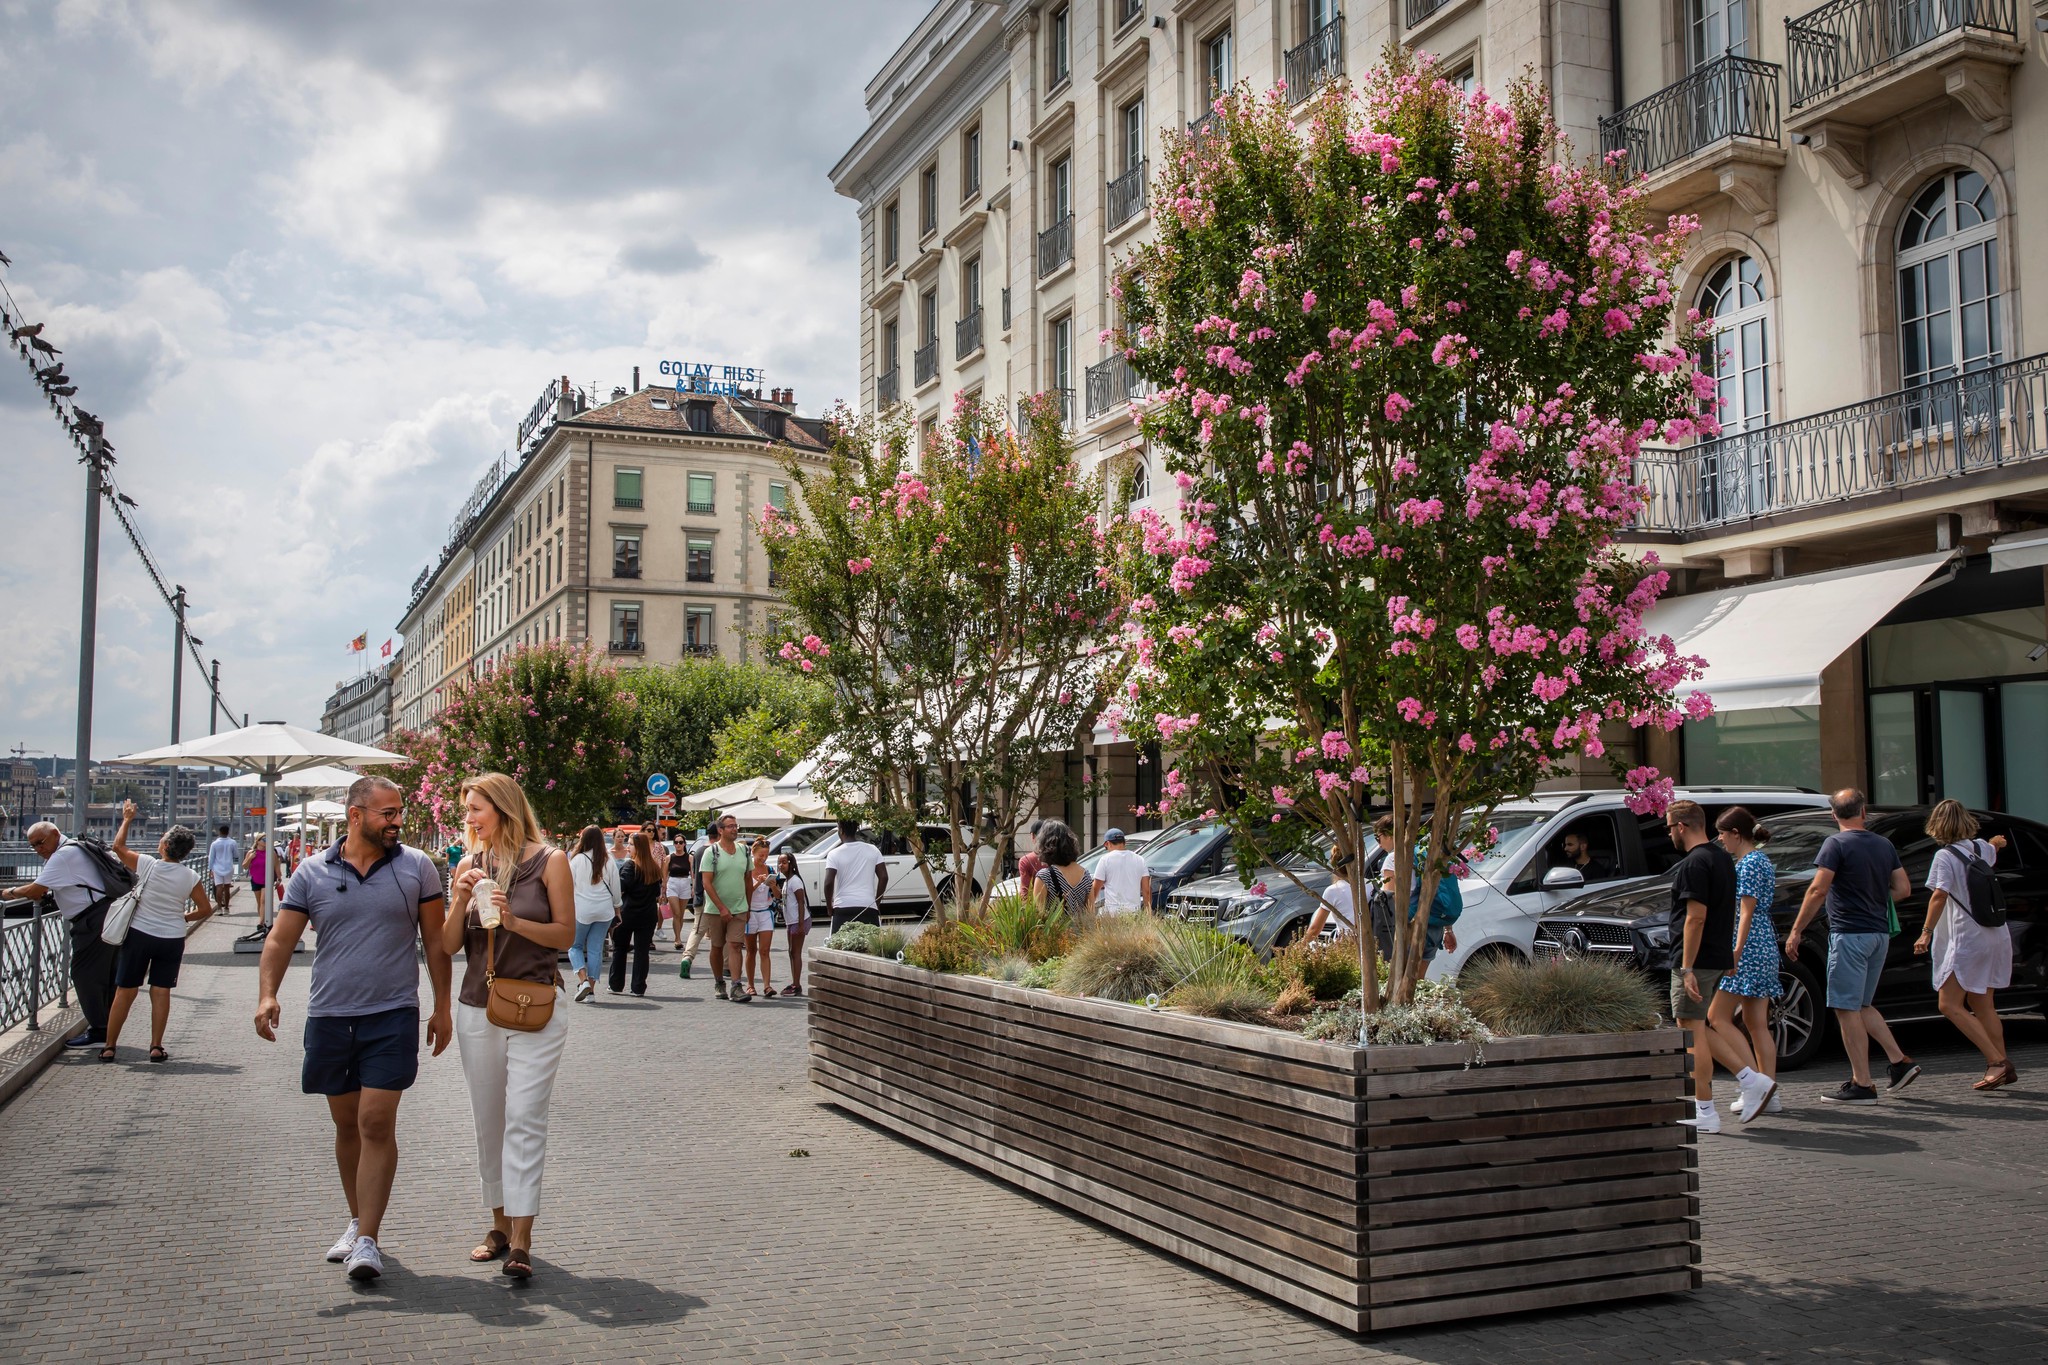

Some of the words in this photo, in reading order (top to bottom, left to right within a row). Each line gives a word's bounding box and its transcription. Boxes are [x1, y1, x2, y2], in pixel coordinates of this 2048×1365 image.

[660, 360, 713, 378] GOLAY
[723, 366, 755, 382] FILS
[676, 378, 687, 393] &
[693, 380, 740, 399] STAHL
